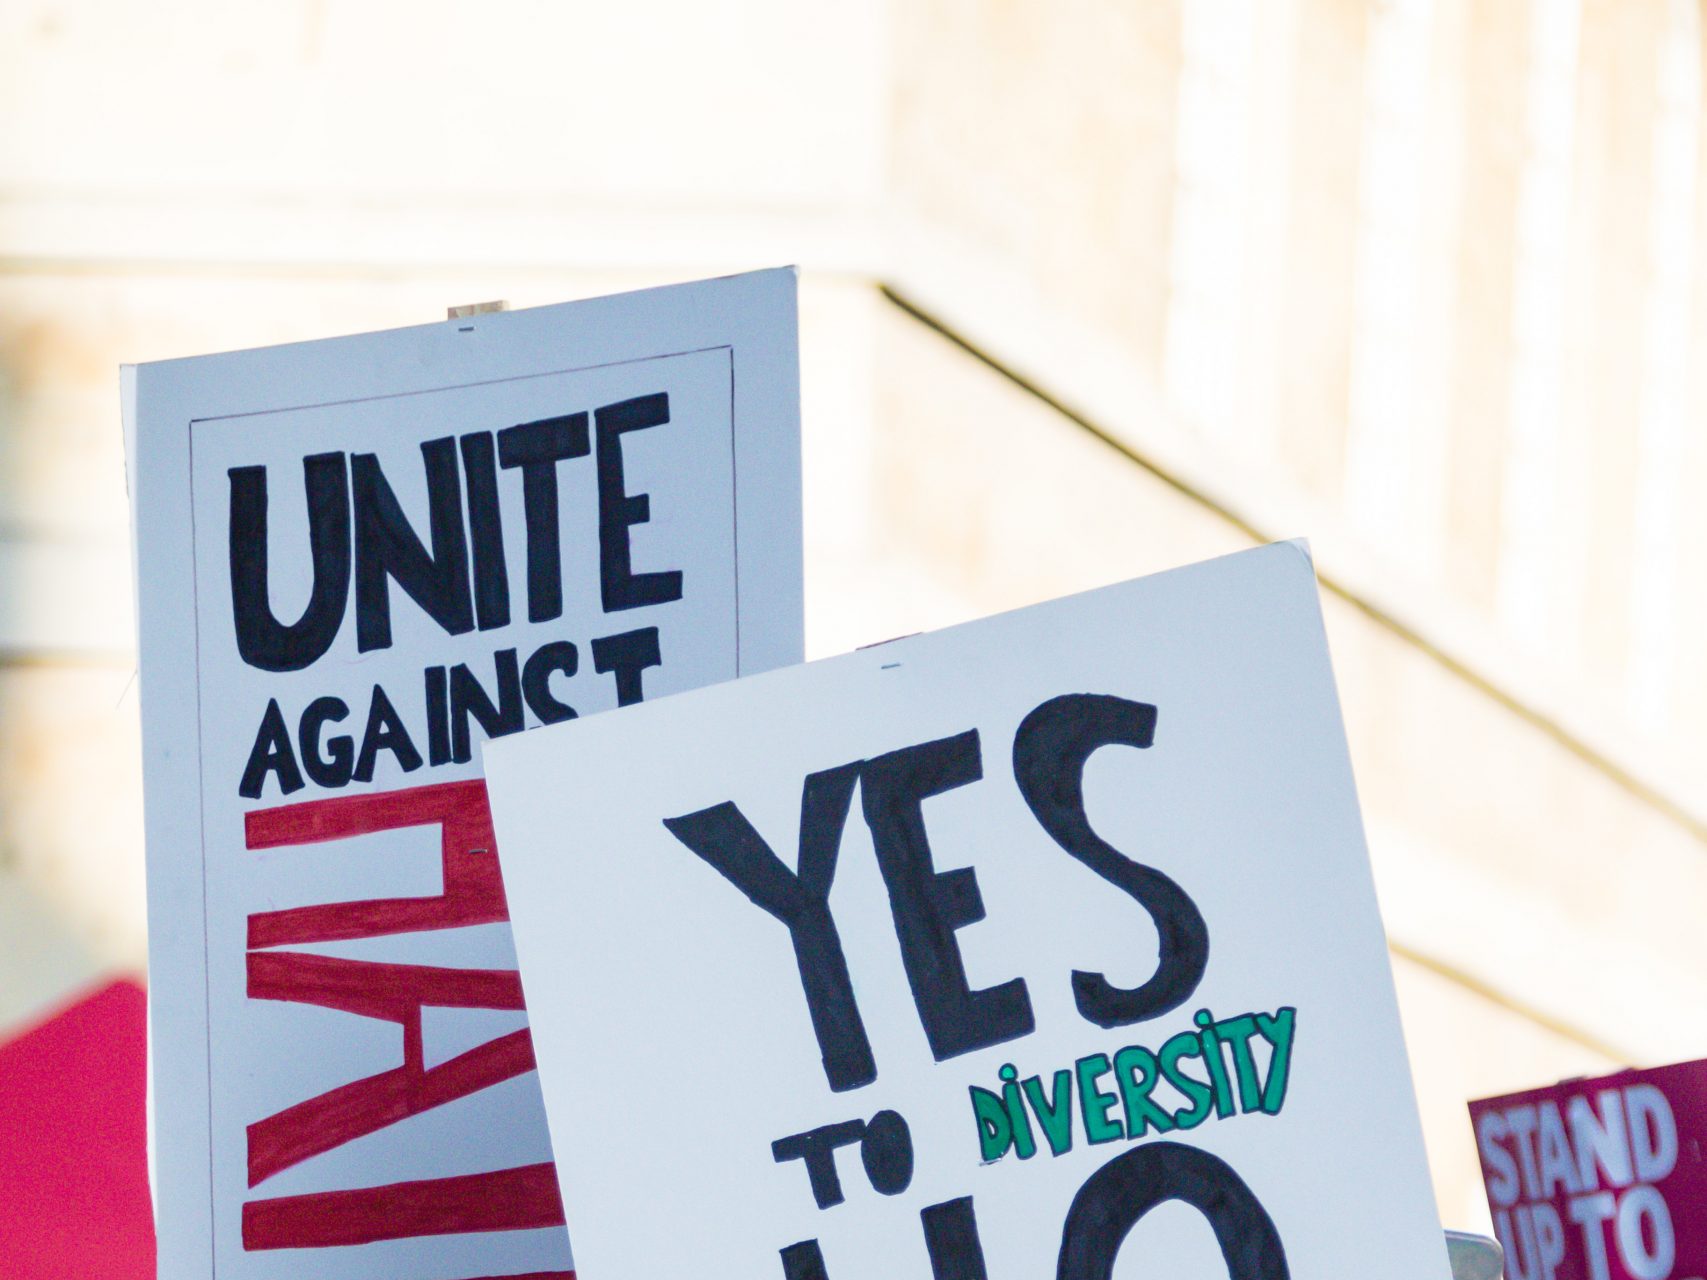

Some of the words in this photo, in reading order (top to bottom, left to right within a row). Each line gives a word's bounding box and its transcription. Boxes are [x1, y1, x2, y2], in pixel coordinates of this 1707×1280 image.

[228, 392, 682, 672] UNITE
[239, 627, 661, 799] AGAINST
[663, 693, 1209, 1093] YES
[771, 1110, 914, 1210] TO
[1478, 1083, 1678, 1207] STAND
